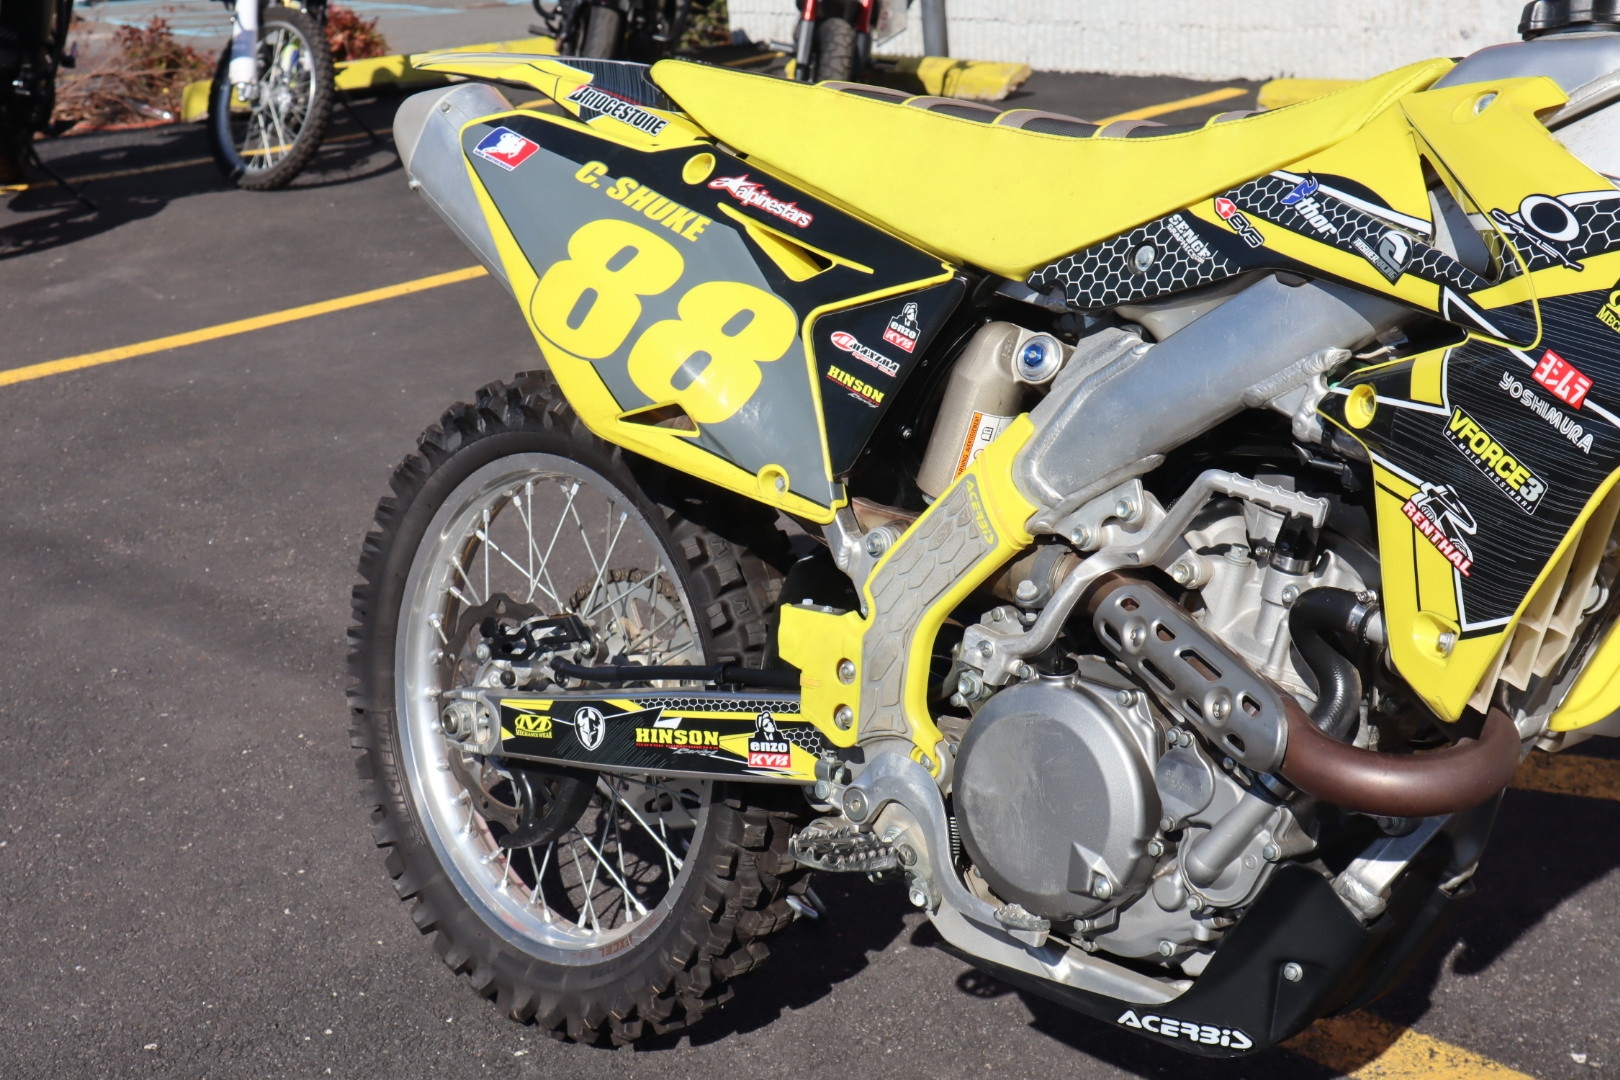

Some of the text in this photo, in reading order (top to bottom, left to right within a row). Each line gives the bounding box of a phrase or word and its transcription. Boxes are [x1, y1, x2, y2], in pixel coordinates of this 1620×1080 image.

[567, 86, 667, 135] BRIDGESTONE
[574, 160, 714, 242] C. SHUKE
[733, 184, 813, 227] alpinestars
[1294, 196, 1338, 235] thor
[1167, 213, 1211, 260] SENGE
[1227, 212, 1265, 248] EVS
[530, 218, 800, 424] 88
[885, 330, 914, 349] KYB
[889, 321, 917, 340] enzo
[1595, 304, 1620, 334] MEC
[827, 364, 885, 403] HINSON
[1533, 352, 1591, 405] ヨシムラ
[1498, 370, 1595, 455] YOSHIMURA
[1449, 408, 1544, 502] VFORCE3
[1458, 441, 1481, 466] MOTO
[1483, 467, 1533, 512] TASSINARI
[1401, 500, 1473, 577] RENTHAL
[635, 727, 720, 746] HINSON
[749, 741, 788, 753] enzo
[750, 753, 789, 767] KYB
